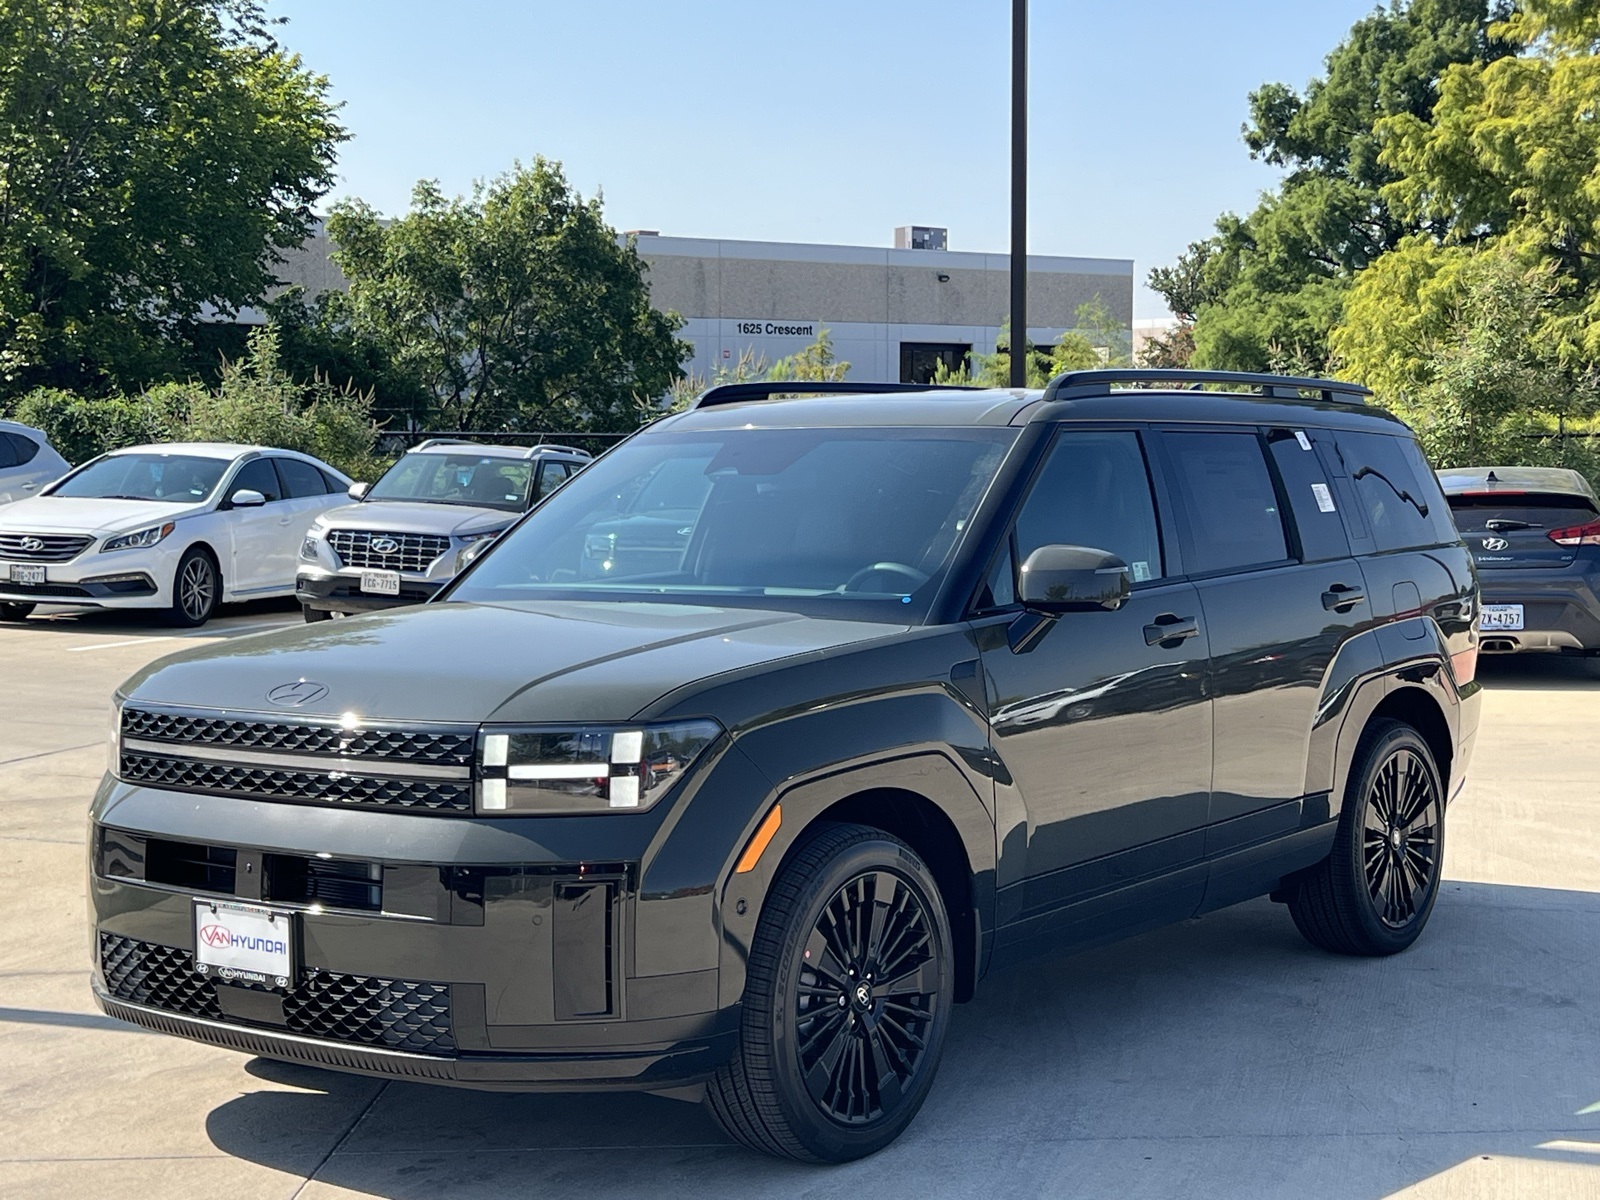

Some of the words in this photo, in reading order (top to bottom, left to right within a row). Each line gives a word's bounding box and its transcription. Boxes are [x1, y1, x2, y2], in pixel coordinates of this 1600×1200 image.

[737, 323, 762, 334] 1625
[765, 323, 813, 336] Crescent
[1481, 613, 1520, 624] ZX-4757
